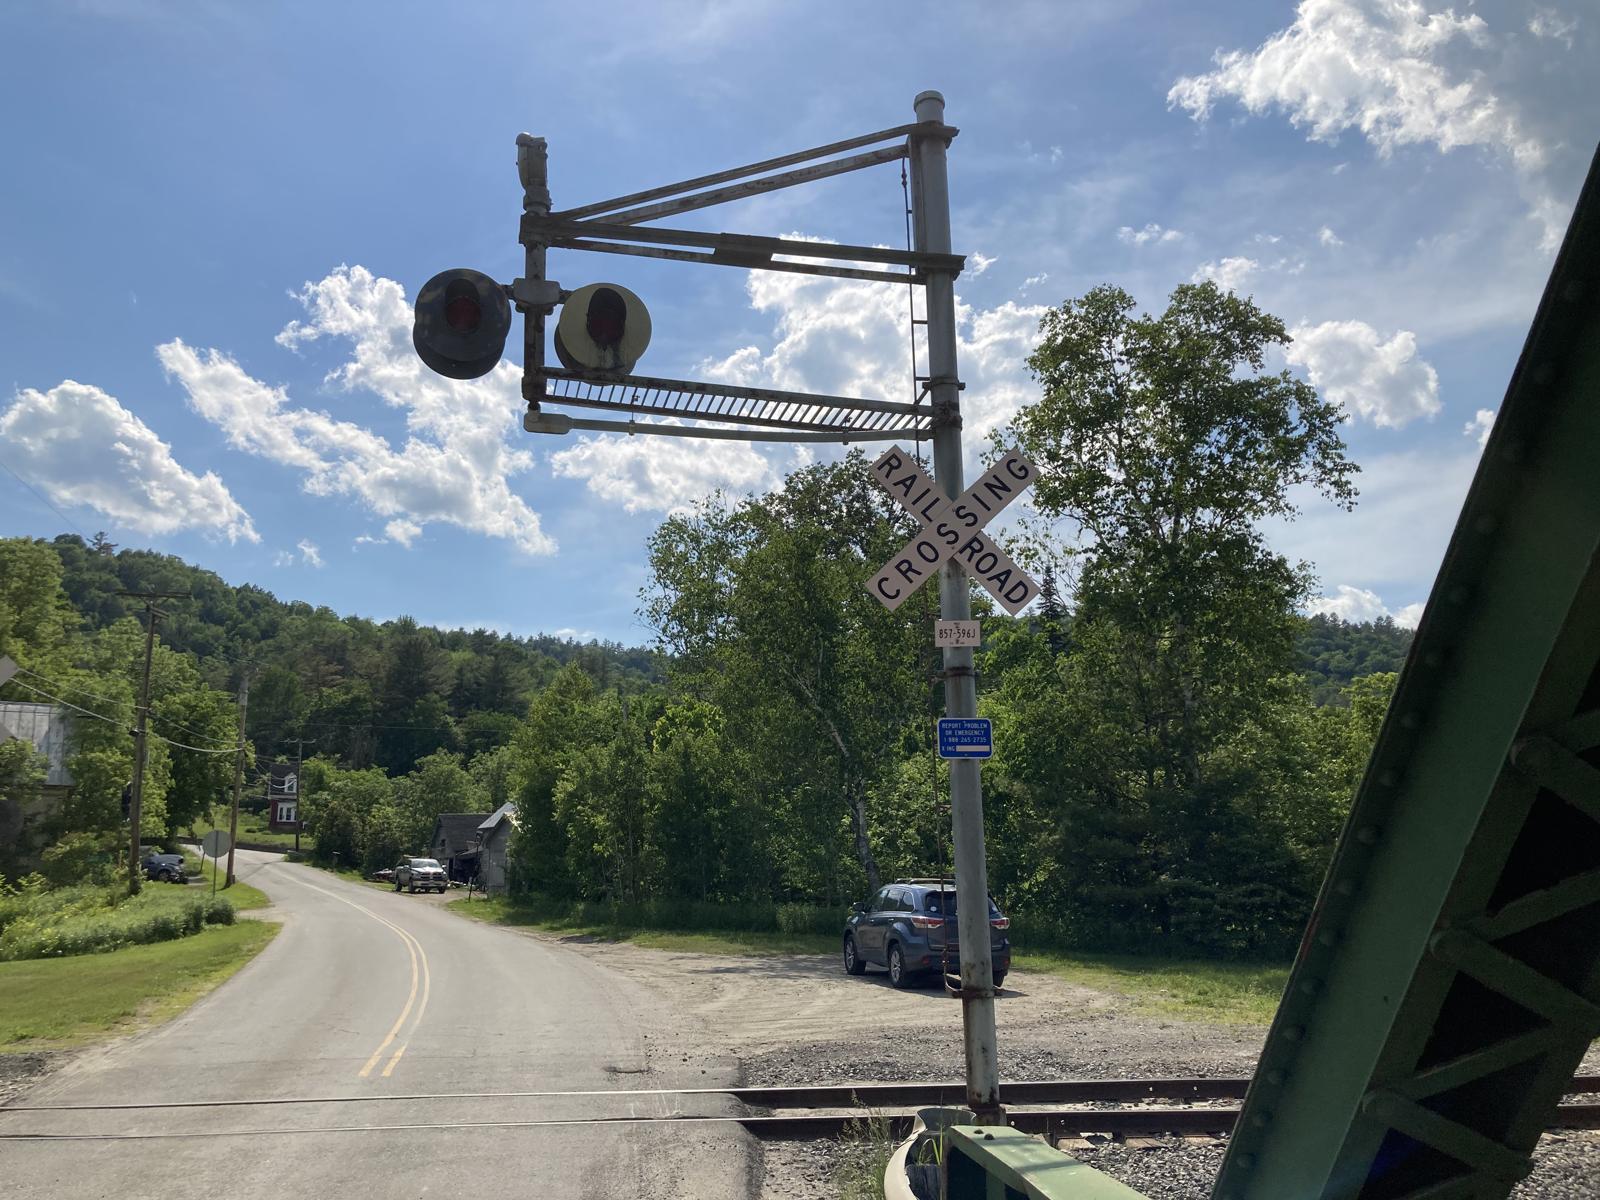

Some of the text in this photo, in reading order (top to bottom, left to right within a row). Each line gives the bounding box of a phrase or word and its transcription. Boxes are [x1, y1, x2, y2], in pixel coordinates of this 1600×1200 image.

[877, 453, 1029, 604] RAIL ROAD
[877, 458, 1029, 600] CROSSING
[939, 629, 976, 639] 857-596J
